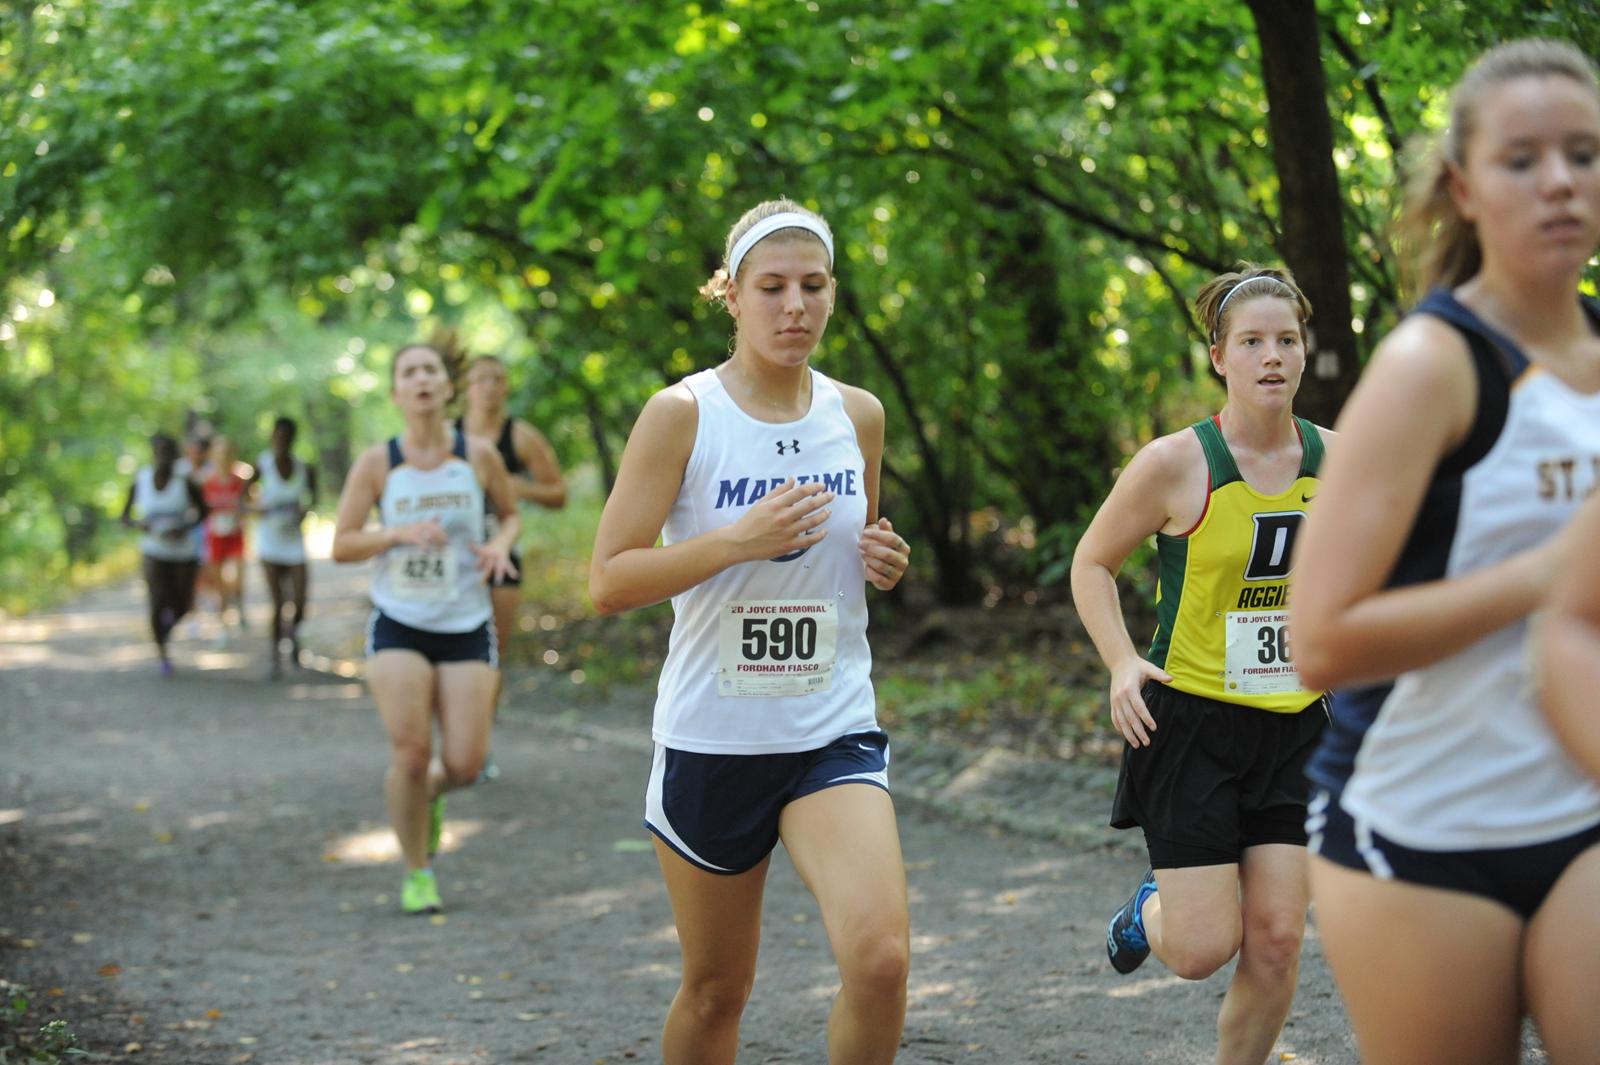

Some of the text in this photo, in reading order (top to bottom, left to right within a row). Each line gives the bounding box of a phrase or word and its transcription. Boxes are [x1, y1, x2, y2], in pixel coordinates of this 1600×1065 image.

[1243, 510, 1309, 581] D
[747, 606, 777, 614] JOYCE
[779, 605, 827, 614] MEMORIAL
[742, 617, 817, 661] 590
[737, 663, 819, 673] FORDHAM FIASCO
[1243, 667, 1281, 675] FORDHAM
